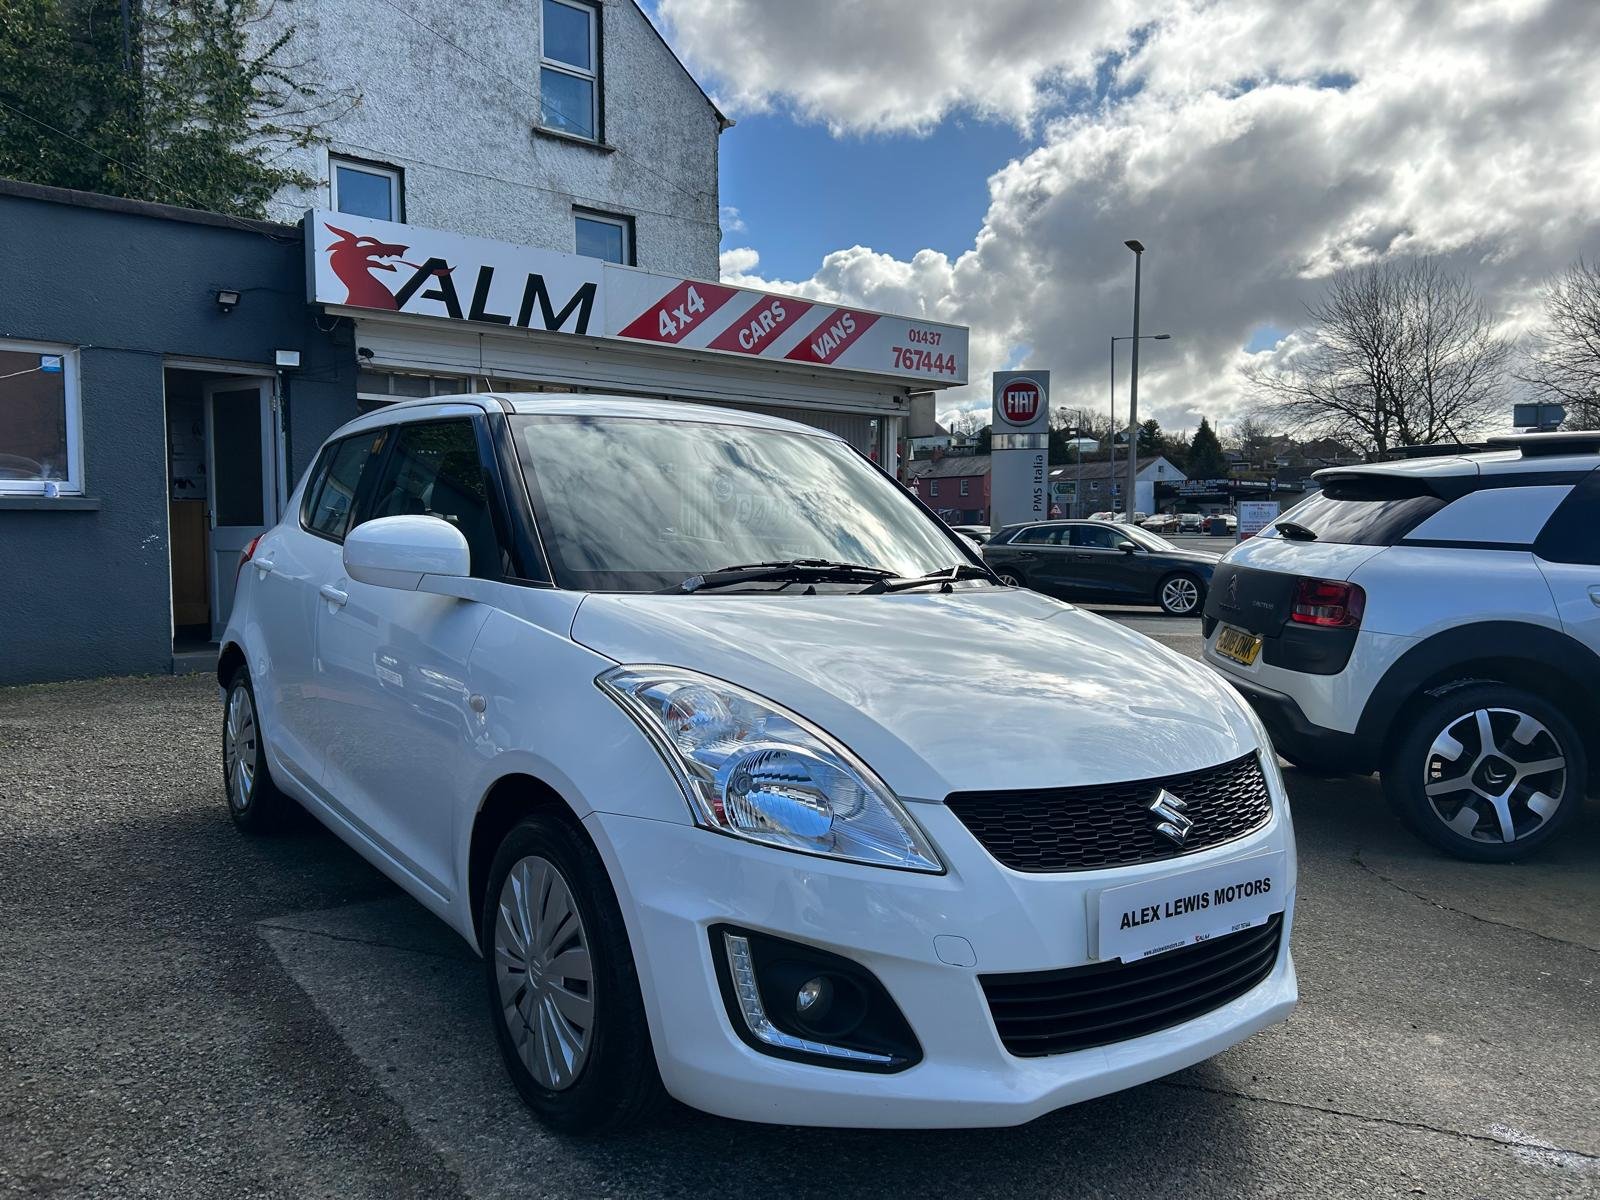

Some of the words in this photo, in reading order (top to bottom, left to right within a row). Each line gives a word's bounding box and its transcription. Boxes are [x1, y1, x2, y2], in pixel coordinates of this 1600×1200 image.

[395, 257, 598, 335] ALM
[658, 285, 705, 338] 4x4
[738, 300, 787, 350] CARS
[810, 312, 857, 360] VANS
[908, 328, 942, 346] 01437
[892, 346, 956, 375] 767444
[1007, 391, 1037, 413] FIAT
[1032, 454, 1044, 483] Italia
[1033, 487, 1043, 511] PMS
[1120, 904, 1161, 931] ALEX
[1165, 892, 1210, 919] LEWIS
[1214, 877, 1272, 906] MOTORS
